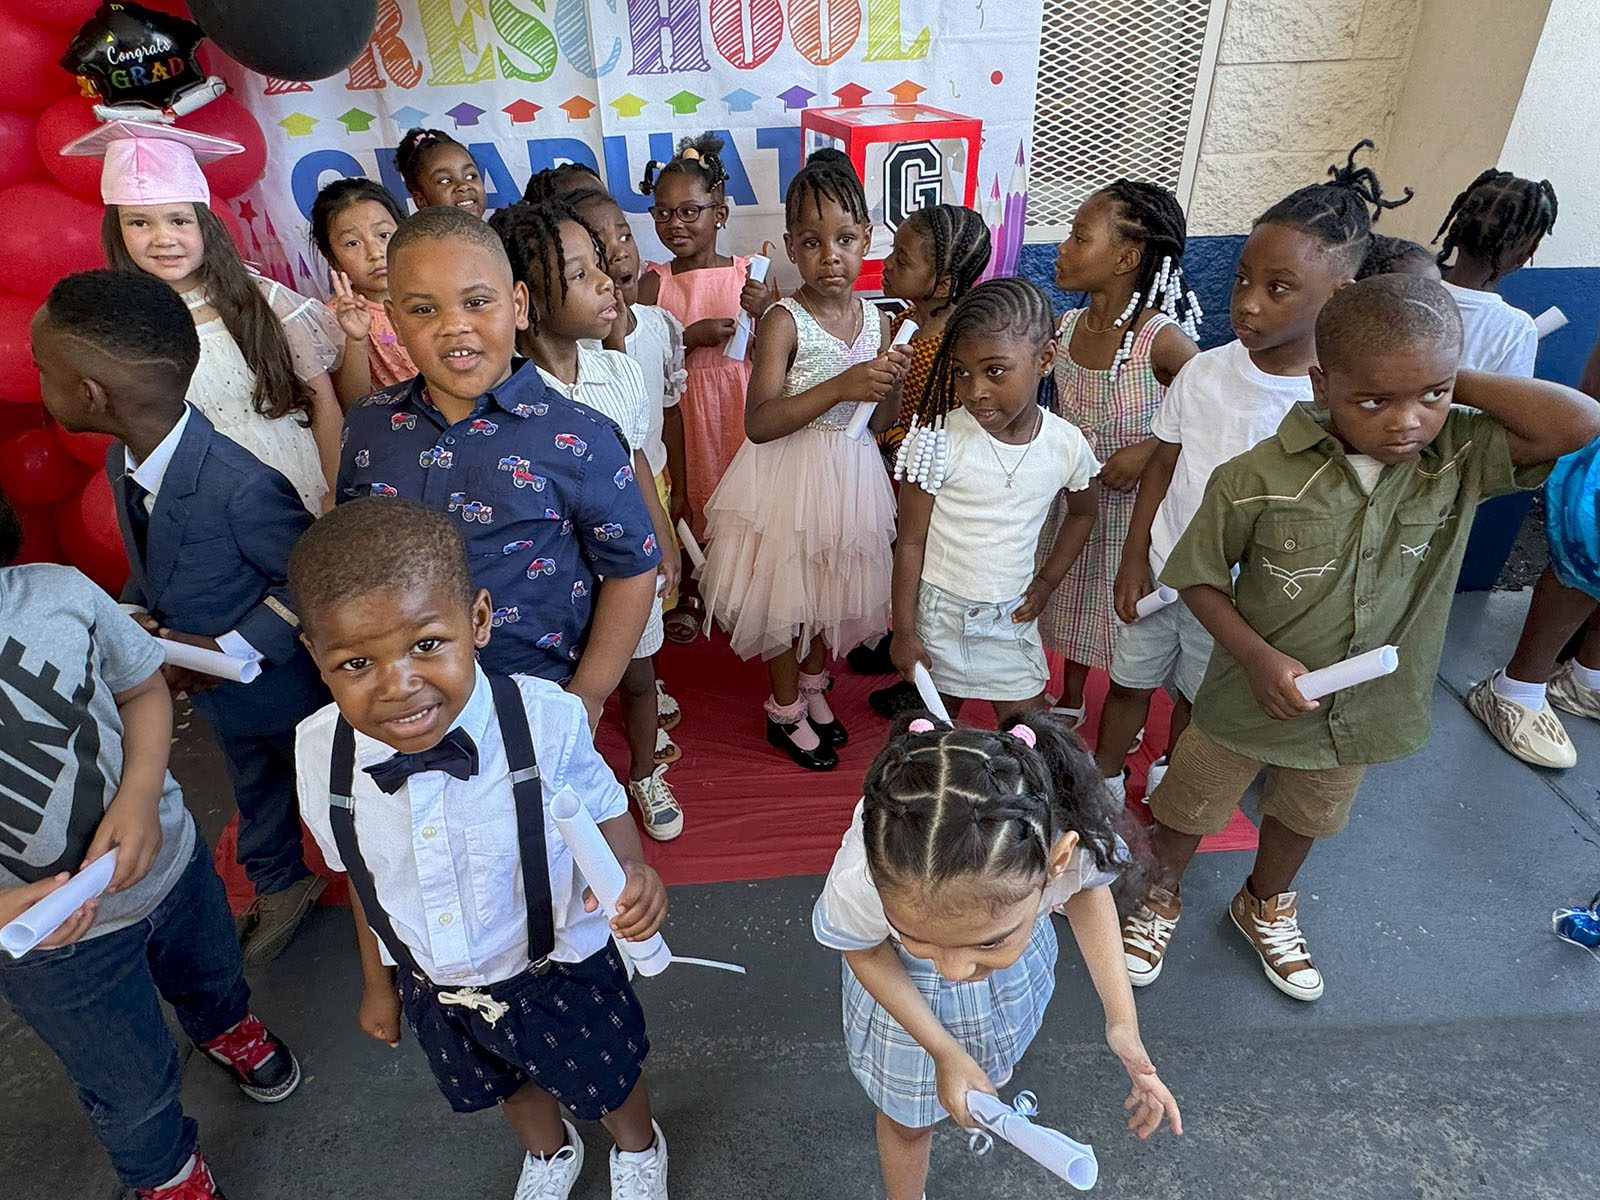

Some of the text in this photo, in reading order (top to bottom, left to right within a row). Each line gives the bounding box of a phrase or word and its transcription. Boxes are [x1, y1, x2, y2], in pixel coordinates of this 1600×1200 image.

[107, 38, 171, 64] Congrats
[111, 57, 185, 88] GRAD
[264, 0, 930, 95] RESCHOOL
[883, 139, 942, 236] G
